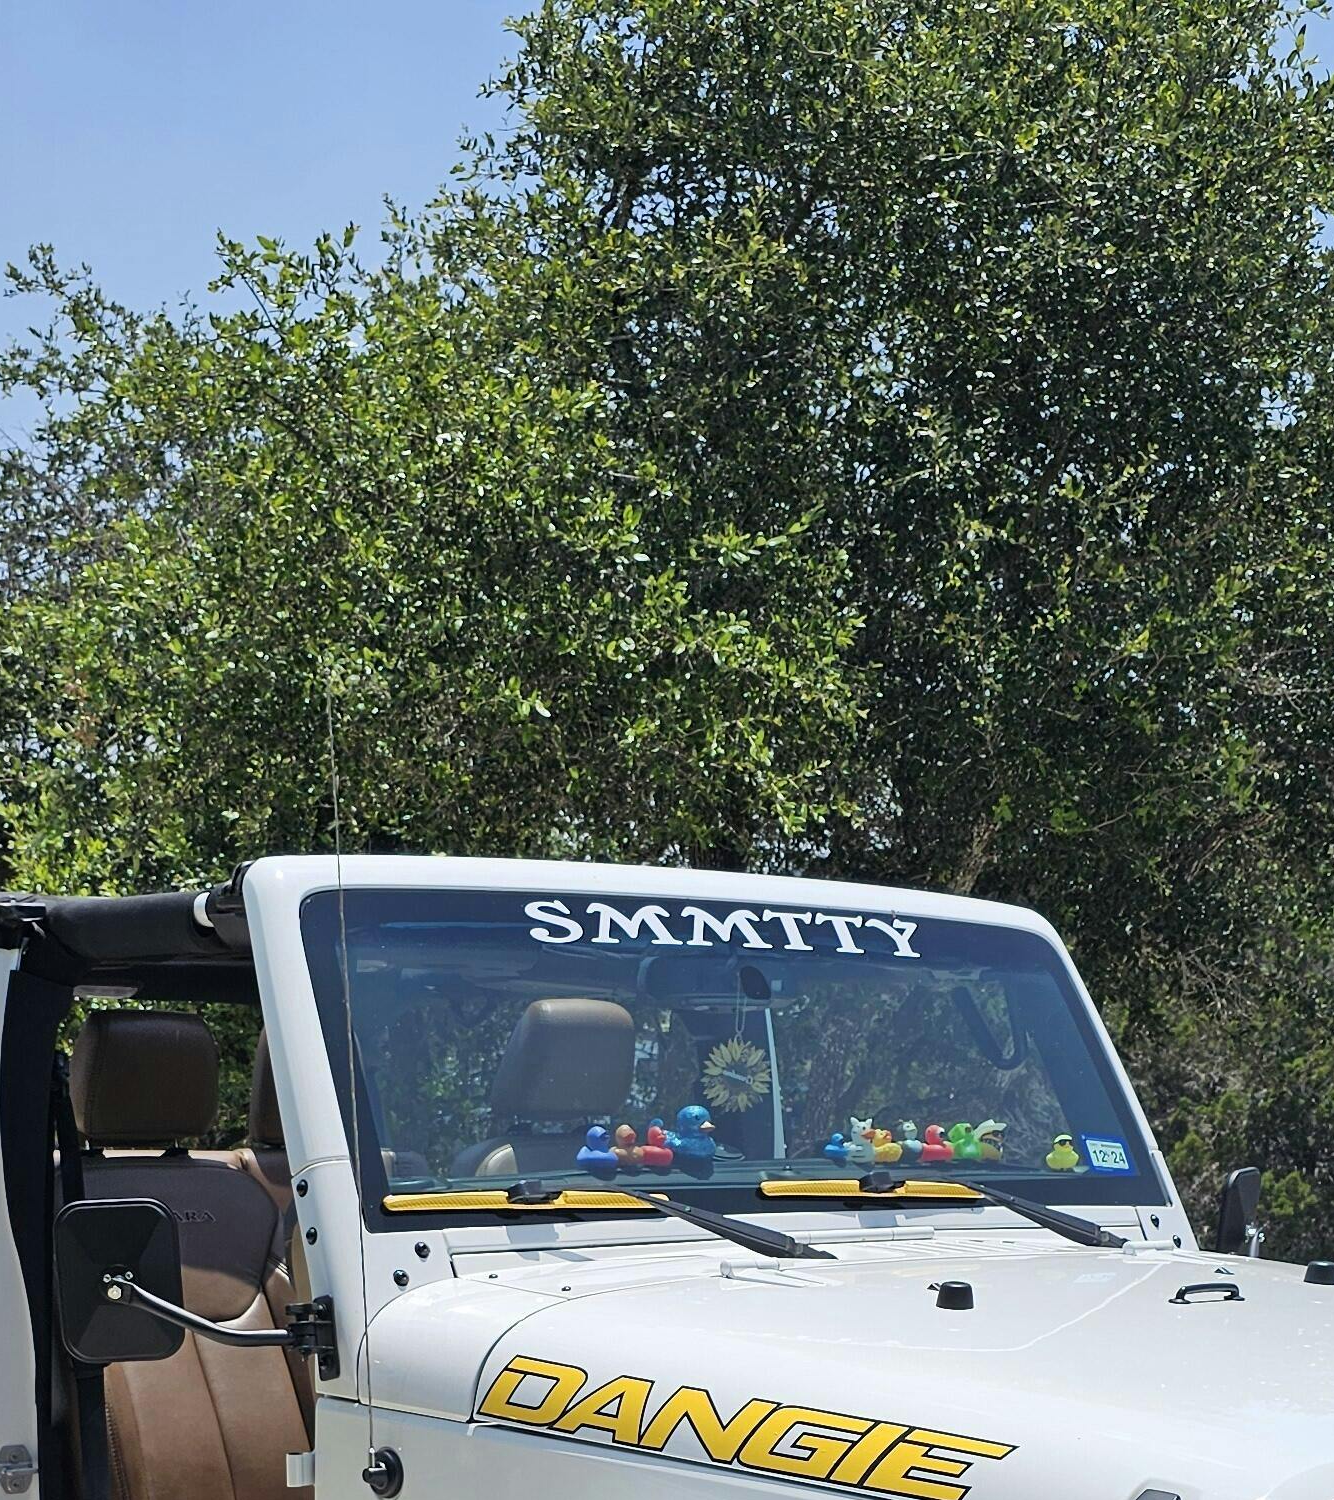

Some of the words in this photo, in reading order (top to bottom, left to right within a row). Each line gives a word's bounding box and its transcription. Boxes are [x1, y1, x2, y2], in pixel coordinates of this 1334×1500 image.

[524, 899, 921, 958] SMMTTY
[1092, 1150, 1108, 1163] 12
[1111, 1151, 1126, 1164] 24
[172, 1209, 216, 1224] ARA
